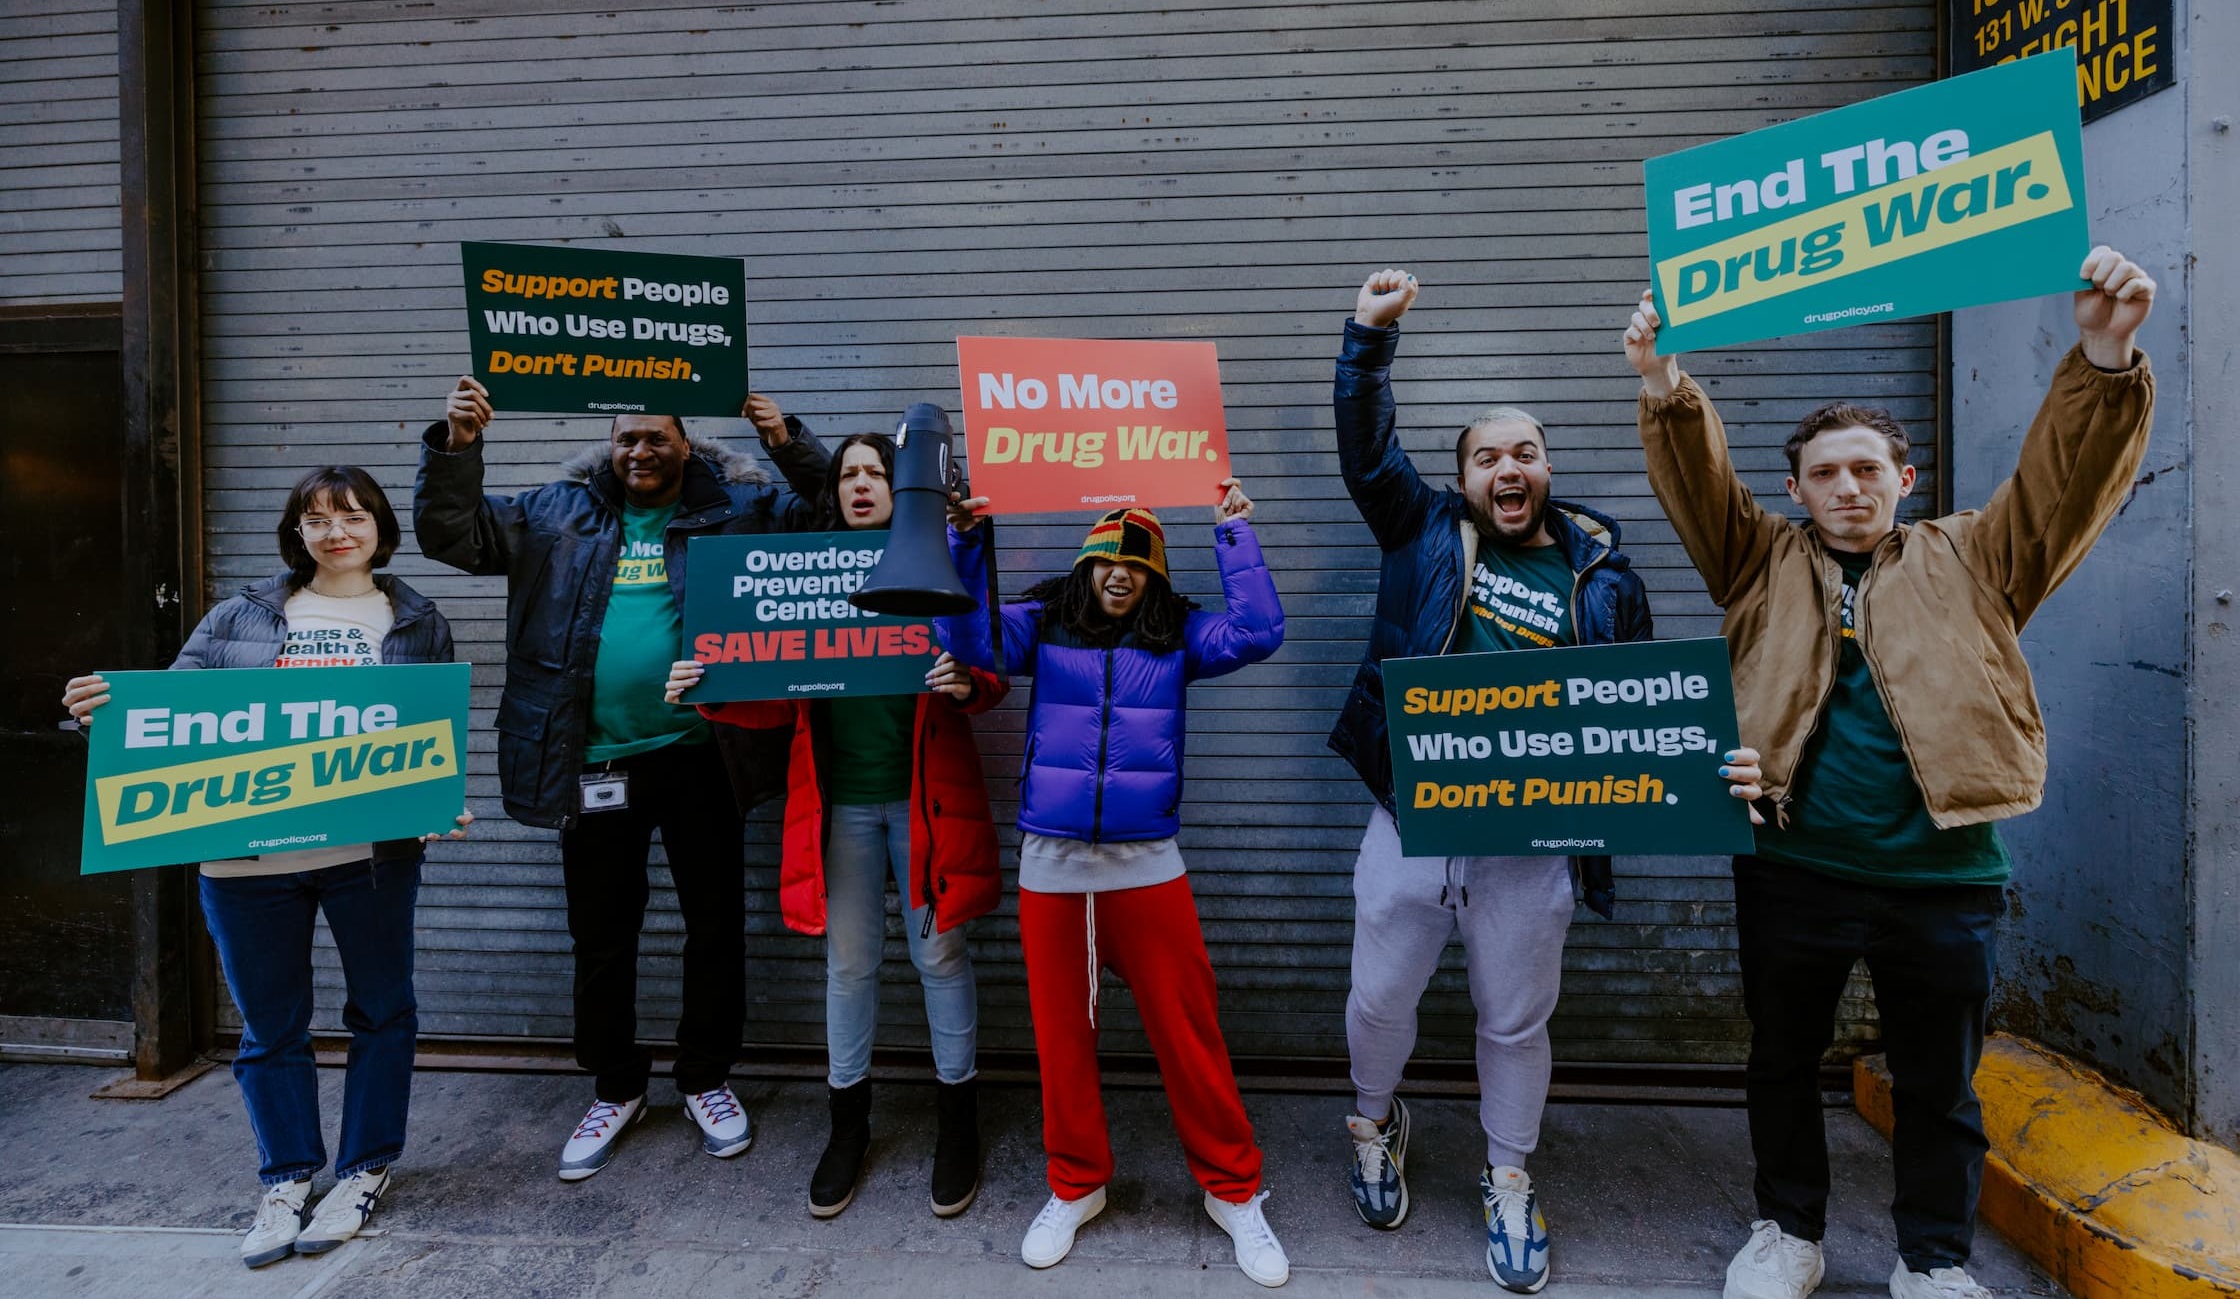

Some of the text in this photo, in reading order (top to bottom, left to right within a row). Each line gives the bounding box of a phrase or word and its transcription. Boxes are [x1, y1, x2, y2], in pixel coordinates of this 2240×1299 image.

[1974, 9, 2011, 56] 131
[1673, 128, 1970, 231] End The
[1676, 159, 2050, 309] Drug War.
[481, 269, 729, 307] Support People
[484, 310, 732, 347] Who Use Drugs,
[1803, 300, 1895, 324] drugpolicy.org
[582, 355, 701, 382] Punish.
[588, 402, 645, 412] drugpolicy.org
[978, 373, 1178, 409] No More
[983, 425, 1218, 468] Drug War.
[1081, 494, 1136, 504] drugpolicy.org
[733, 570, 870, 598] Preventi
[287, 628, 364, 641] rugs &
[354, 642, 371, 654] &
[694, 624, 941, 665] SAVE LIVES.
[788, 682, 845, 693] drugpolicy.org
[1403, 671, 1709, 717] Support People
[125, 700, 398, 749] End The
[1407, 725, 1717, 761] Who Use Drugs,
[115, 736, 446, 827] Drug War.
[1523, 774, 1678, 806] Punish.
[248, 832, 327, 848] drugpolicy.org
[1531, 838, 1605, 849] drugpolicy.org
